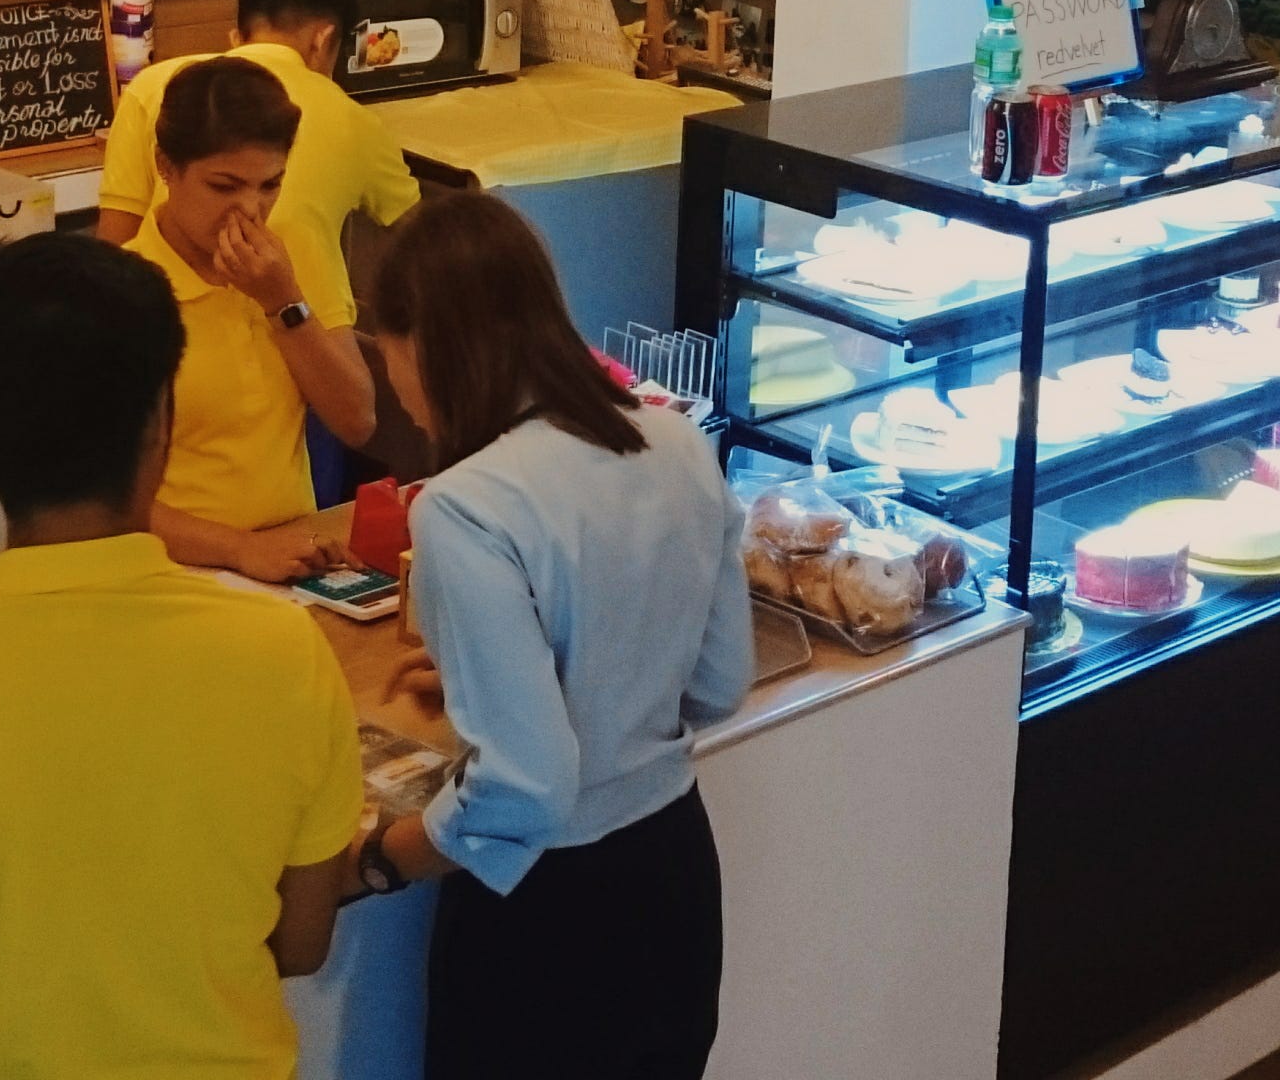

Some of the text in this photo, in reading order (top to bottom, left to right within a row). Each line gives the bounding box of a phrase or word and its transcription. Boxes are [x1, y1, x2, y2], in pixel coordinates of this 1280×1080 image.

[58, 25, 80, 49] is
[79, 17, 104, 42] not
[1036, 29, 1107, 71] redvelvet
[38, 46, 77, 80] for
[11, 79, 38, 97] or
[43, 69, 100, 96] Loss
[993, 128, 1007, 164] zero
